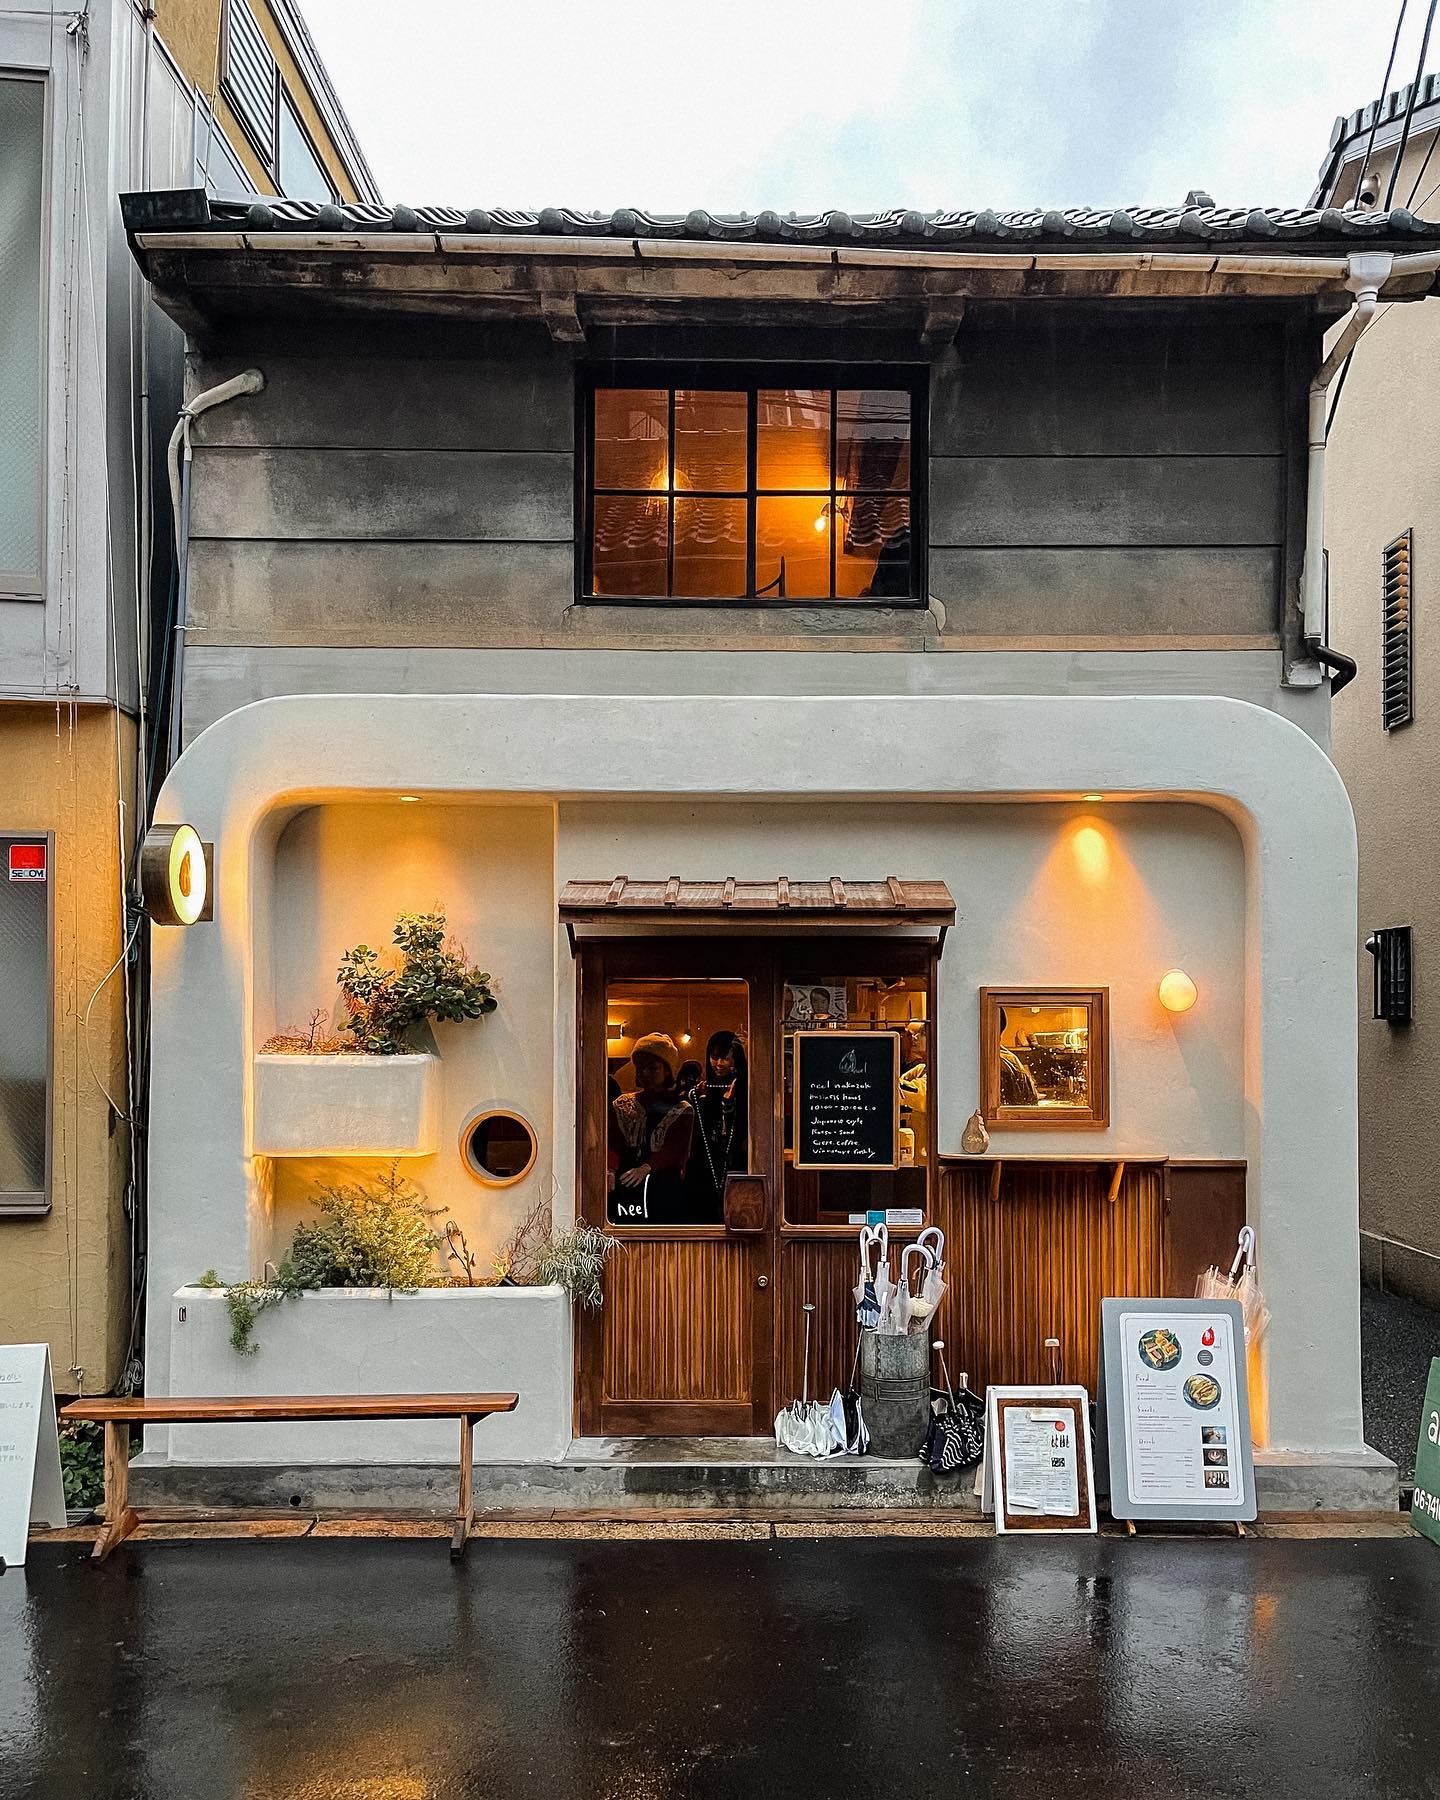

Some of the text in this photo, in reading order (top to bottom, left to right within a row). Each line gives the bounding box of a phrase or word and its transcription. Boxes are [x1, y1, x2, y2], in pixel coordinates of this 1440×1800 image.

[12, 870, 44, 878] SECOM
[618, 1174, 651, 1219] neel
[1414, 1487, 1440, 1521] 06-741
